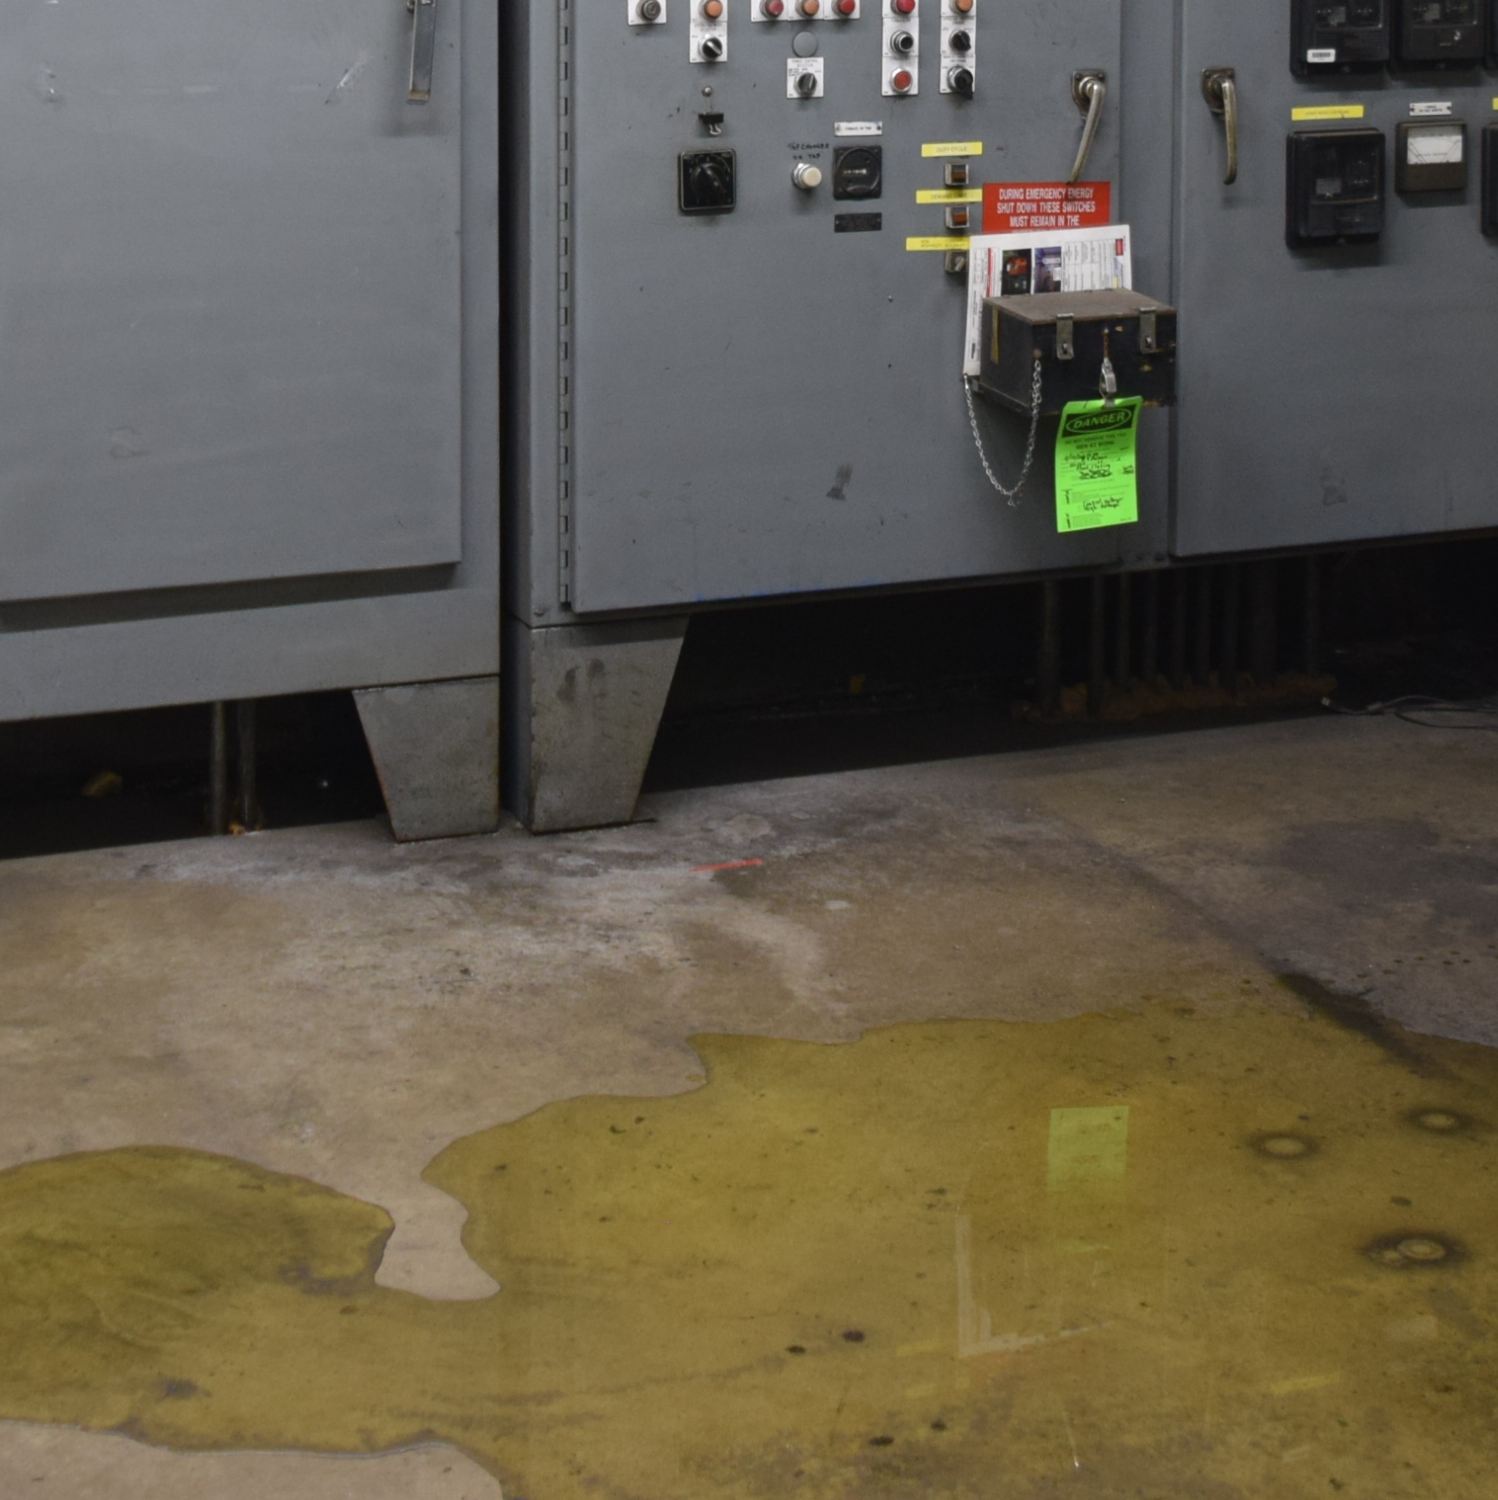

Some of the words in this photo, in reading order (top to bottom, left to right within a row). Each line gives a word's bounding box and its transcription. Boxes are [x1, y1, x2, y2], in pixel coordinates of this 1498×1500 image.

[1000, 188, 1023, 199] DURING
[1026, 188, 1066, 199] EMERGENCY
[1068, 188, 1093, 198] ENERGY
[997, 203, 1014, 214] SHUT
[1016, 202, 1036, 213] DOWN
[1039, 202, 1060, 213] THESE
[1063, 201, 1095, 212] SWITCHES
[1010, 216, 1027, 227] MUST
[1030, 216, 1056, 226] REMAIN
[1058, 215, 1064, 226] IN
[1067, 215, 1079, 226] THE
[1073, 411, 1124, 428] DANGER
